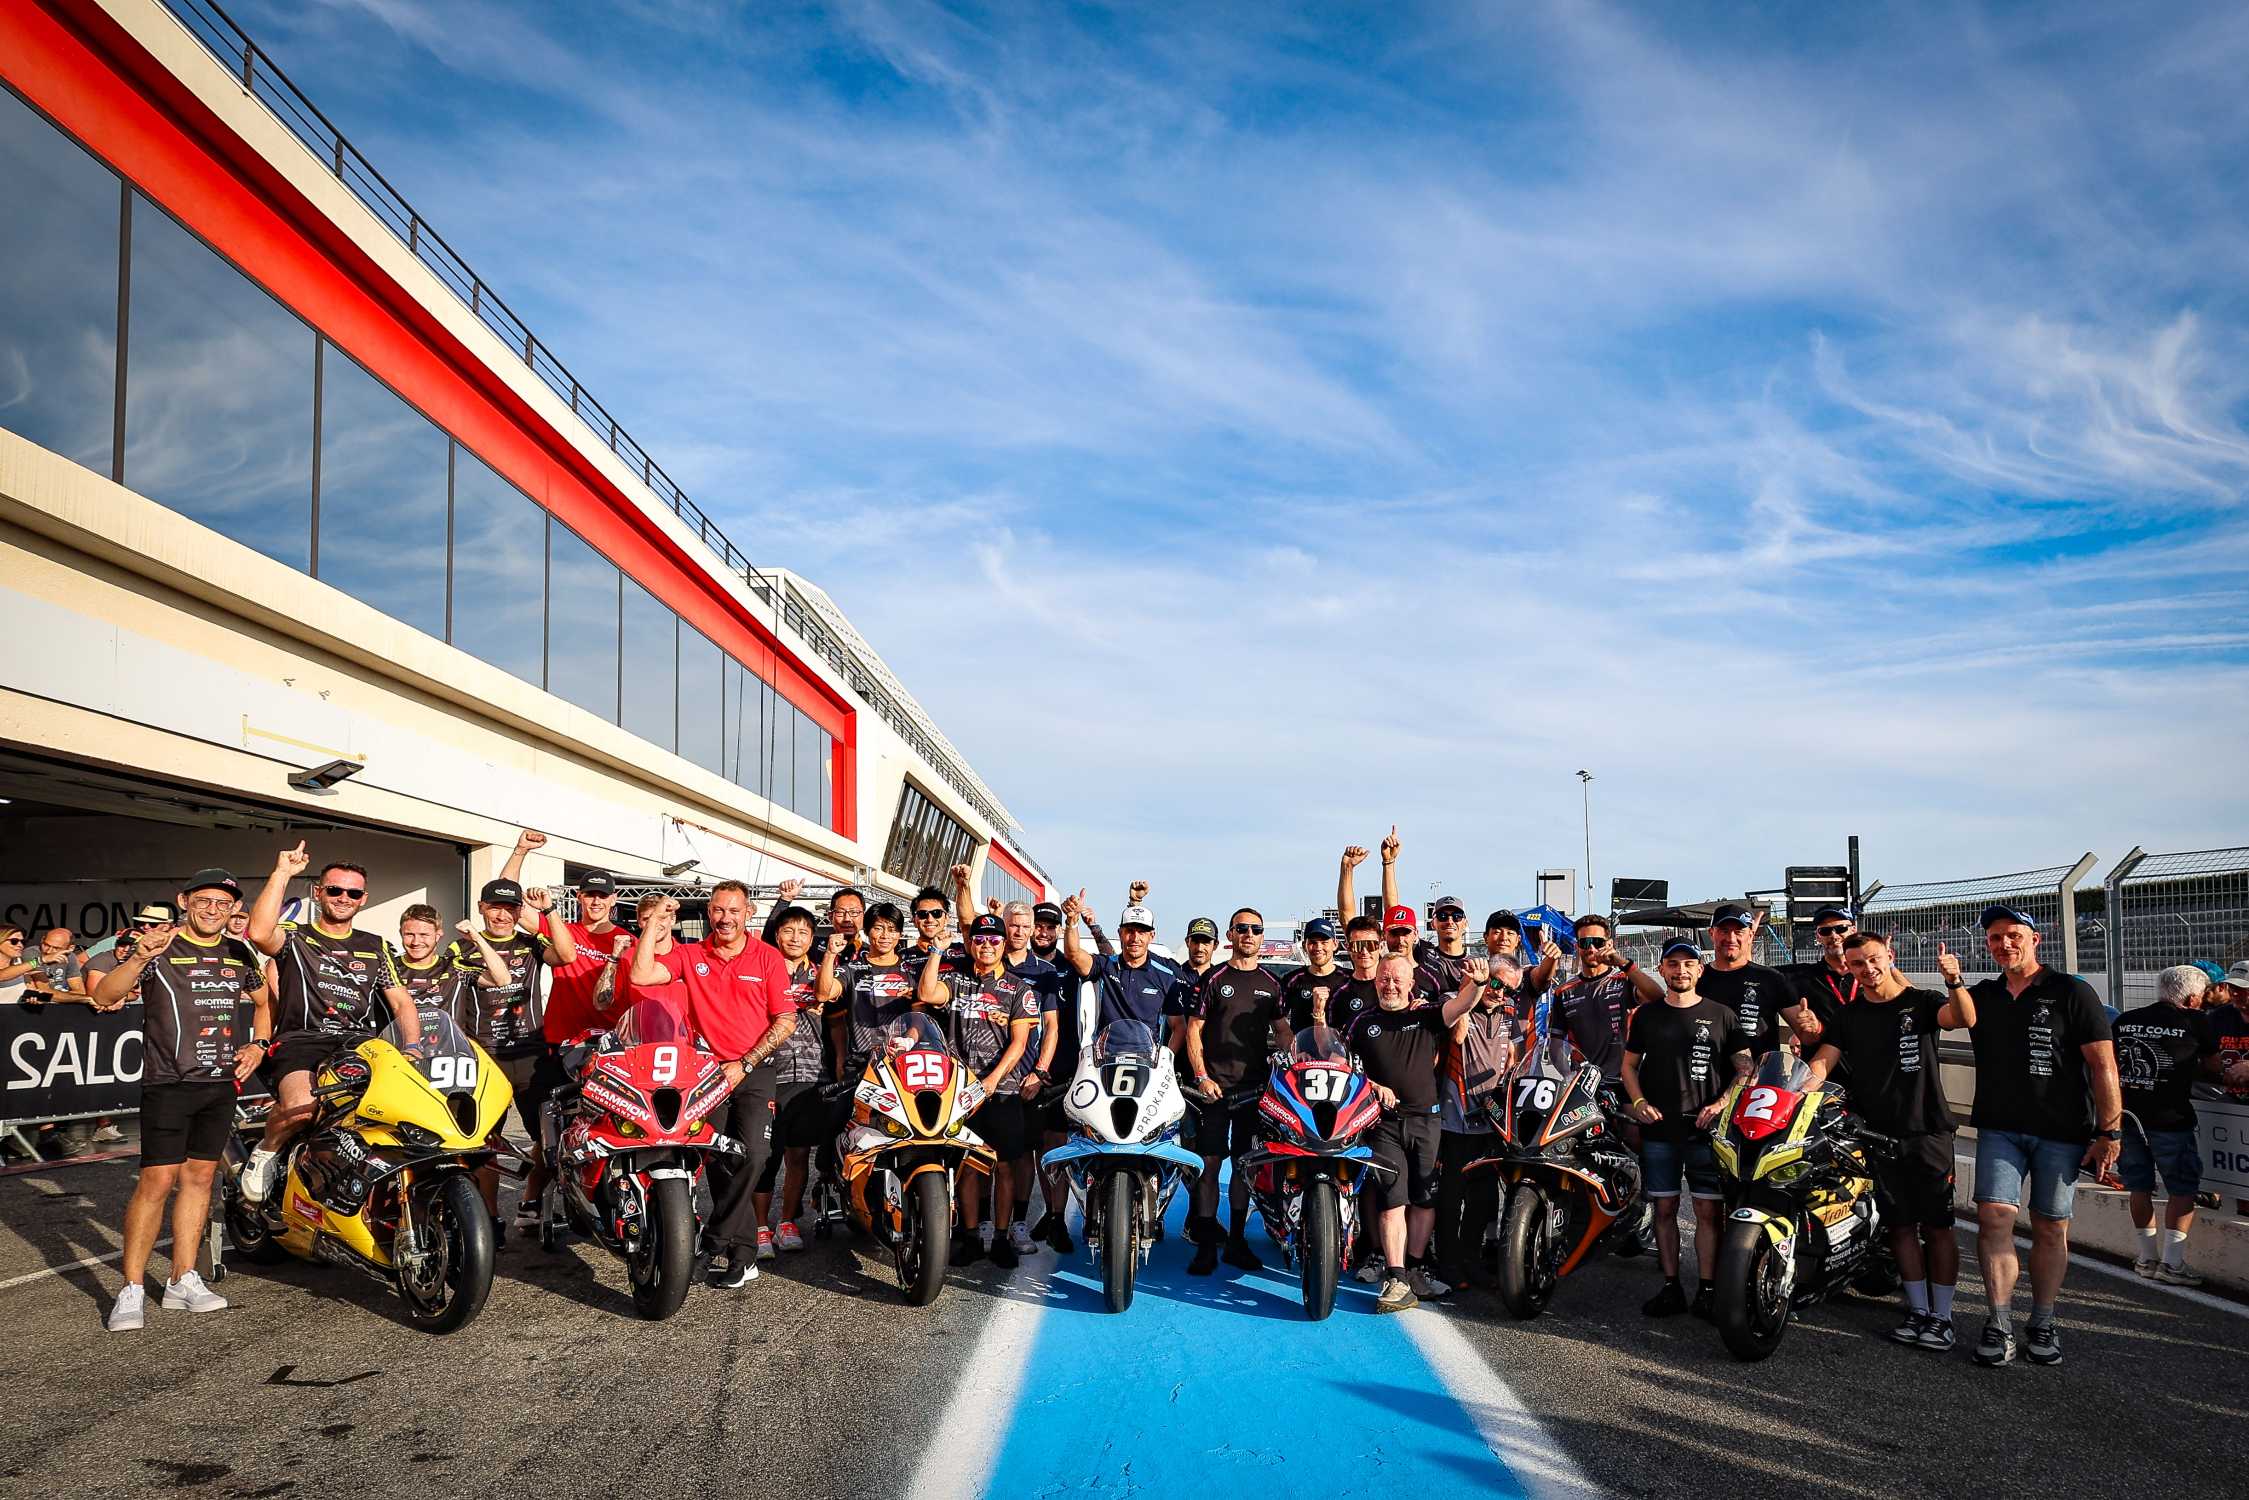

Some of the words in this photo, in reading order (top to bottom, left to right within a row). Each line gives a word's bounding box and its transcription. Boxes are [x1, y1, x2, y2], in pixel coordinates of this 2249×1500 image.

[191, 981, 240, 992] HAAS
[2120, 1024, 2144, 1033] WEST
[2146, 1026, 2186, 1038] COAST
[7, 1030, 144, 1090] SALO
[429, 1056, 477, 1089] 90
[652, 1046, 678, 1082] 9
[905, 1053, 944, 1086] 25
[1111, 1065, 1138, 1096] 6
[1304, 1068, 1350, 1102] 37
[1515, 1078, 1556, 1110] 76
[586, 1081, 651, 1121] CHAMPION
[591, 1093, 636, 1121] LUBRICANTS
[683, 1079, 729, 1121] CHAMPION
[1744, 1088, 1778, 1120] 2
